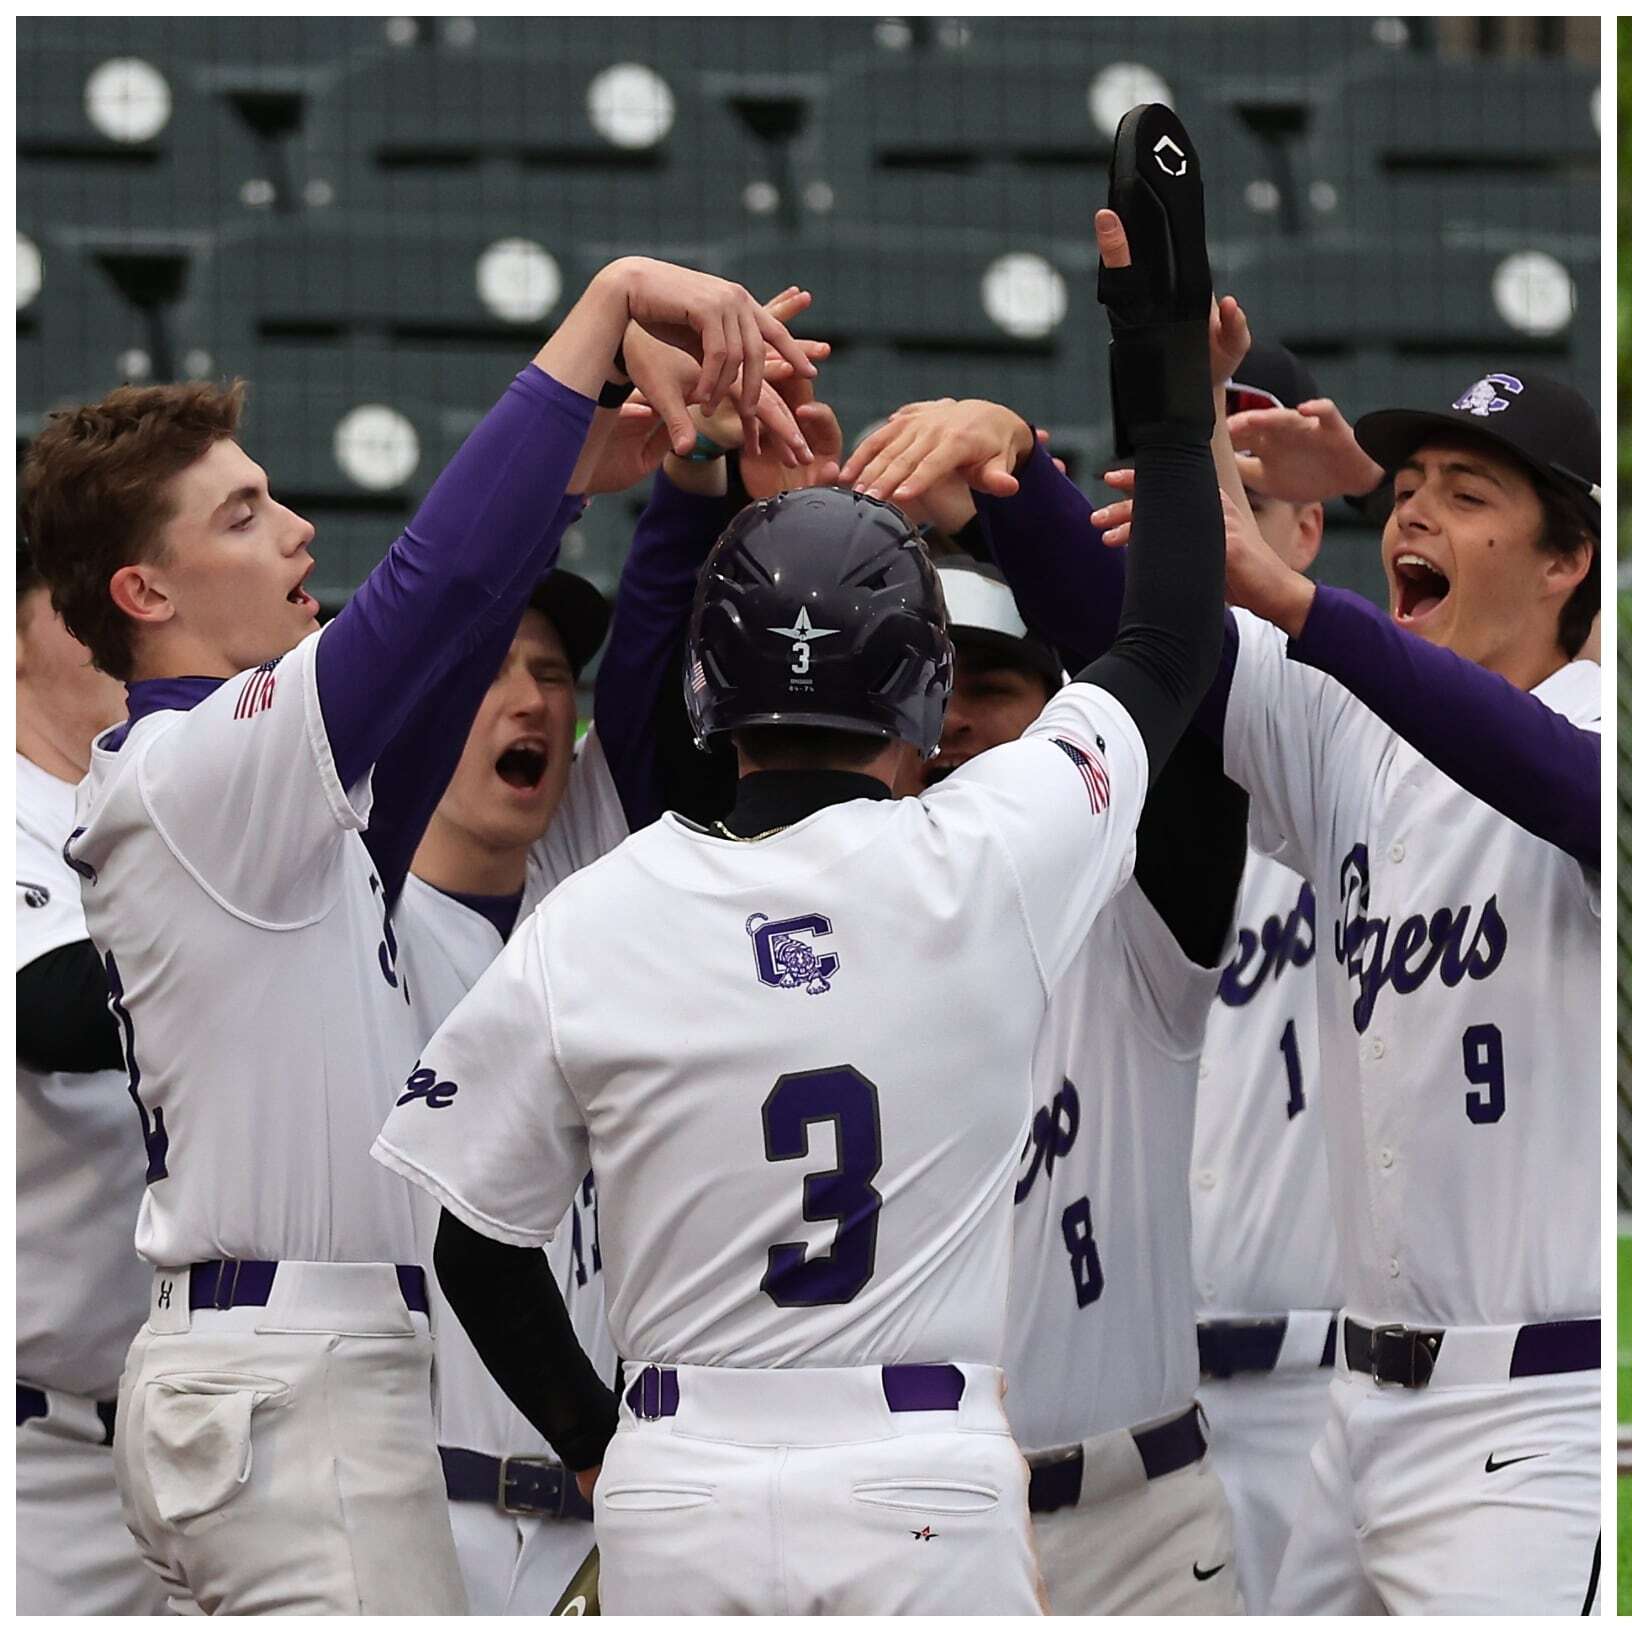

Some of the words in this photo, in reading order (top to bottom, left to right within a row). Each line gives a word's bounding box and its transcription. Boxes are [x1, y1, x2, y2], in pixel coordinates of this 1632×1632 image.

[791, 641, 810, 674] 3
[745, 911, 841, 995] C
[1216, 880, 1316, 1006] ers
[1279, 1018, 1307, 1122] 1
[1462, 1021, 1507, 1125] 9
[760, 1063, 884, 1309] 3
[1061, 1195, 1105, 1311] 8
